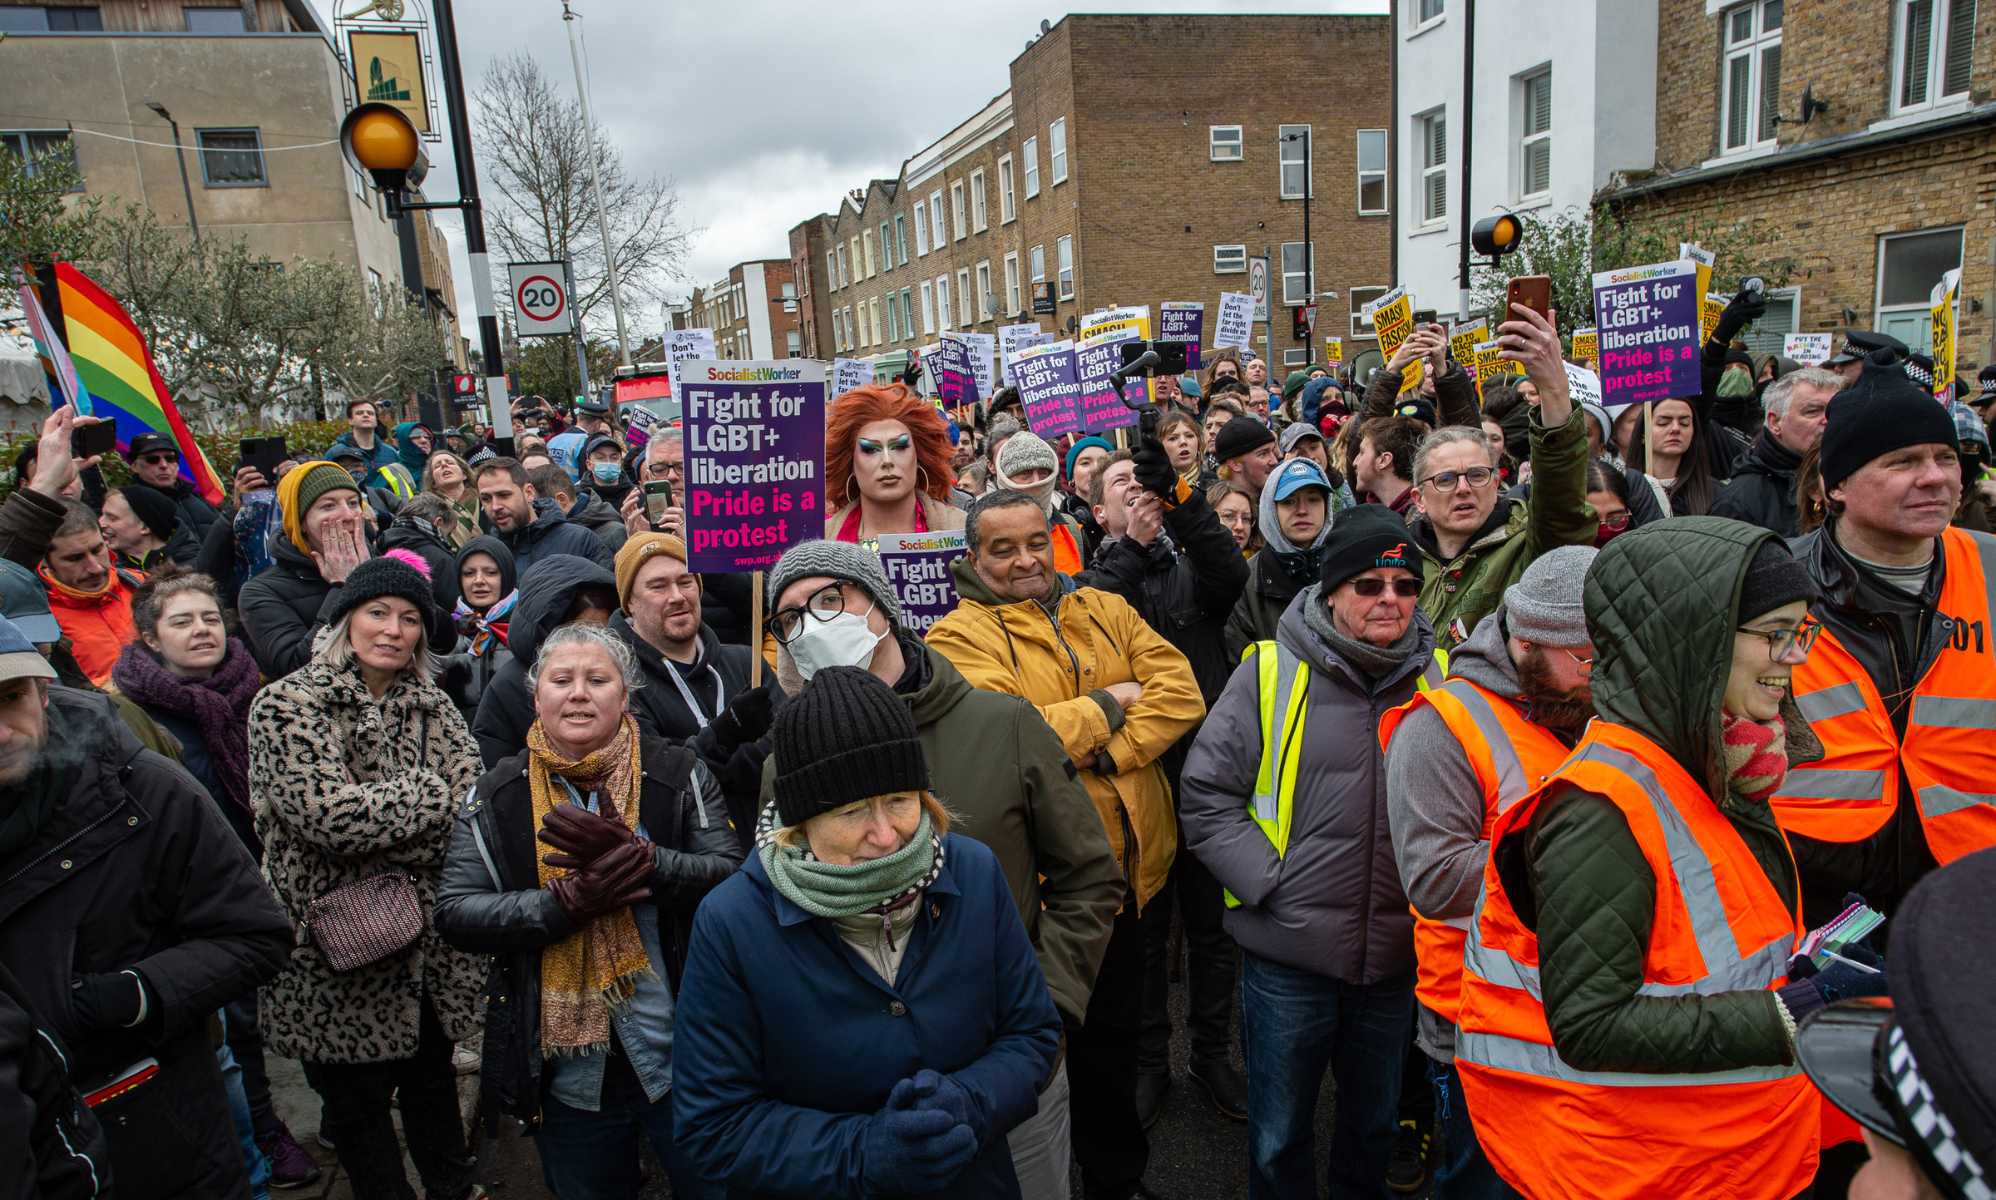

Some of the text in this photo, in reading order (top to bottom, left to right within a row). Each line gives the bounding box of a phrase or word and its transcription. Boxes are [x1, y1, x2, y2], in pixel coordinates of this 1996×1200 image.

[1253, 274, 1264, 290] 20
[1611, 267, 1678, 283] SocialistWorker
[524, 288, 557, 307] 20
[1600, 283, 1681, 309] Fight for
[1162, 311, 1197, 322] Fight for
[1223, 310, 1243, 319] let the
[1224, 303, 1241, 311] Don't
[1253, 305, 1266, 316] ONE
[1375, 302, 1404, 330] SMASH
[1090, 312, 1136, 326] SocialistWorker
[1221, 318, 1247, 329] far right
[1601, 305, 1663, 329] LGBT+
[1162, 322, 1189, 332] LGBT+
[1162, 332, 1199, 341] liberation
[1220, 326, 1239, 335] divide
[1452, 332, 1474, 345] NO TO
[1602, 324, 1690, 350] liberation
[671, 342, 694, 352] Don't
[686, 352, 700, 360] the
[1078, 346, 1110, 366] Fight
[1455, 350, 1466, 359] NO
[1575, 348, 1598, 357] FASCIS
[1014, 356, 1068, 377] Fight for
[1603, 345, 1693, 370] Pride is a
[708, 367, 800, 381] SocialistWorker
[840, 369, 858, 378] Don't
[1080, 360, 1120, 381] LGBT+
[1479, 361, 1517, 379] FASCISM
[1019, 370, 1060, 391] LGBT+
[1605, 366, 1672, 394] protest
[1023, 382, 1081, 404] liberation
[1085, 391, 1117, 409] Pride
[1135, 387, 1144, 397] a
[689, 390, 805, 424] Fight for
[1028, 395, 1075, 417] Pride is
[1033, 410, 1078, 433] protest
[690, 424, 780, 453] LGBT+
[691, 455, 814, 485] liberation
[692, 487, 815, 517] Pride is a
[693, 518, 788, 553] protest
[900, 536, 965, 550] SocialistWor
[887, 558, 946, 583] Fight
[1944, 616, 1984, 654] 01
